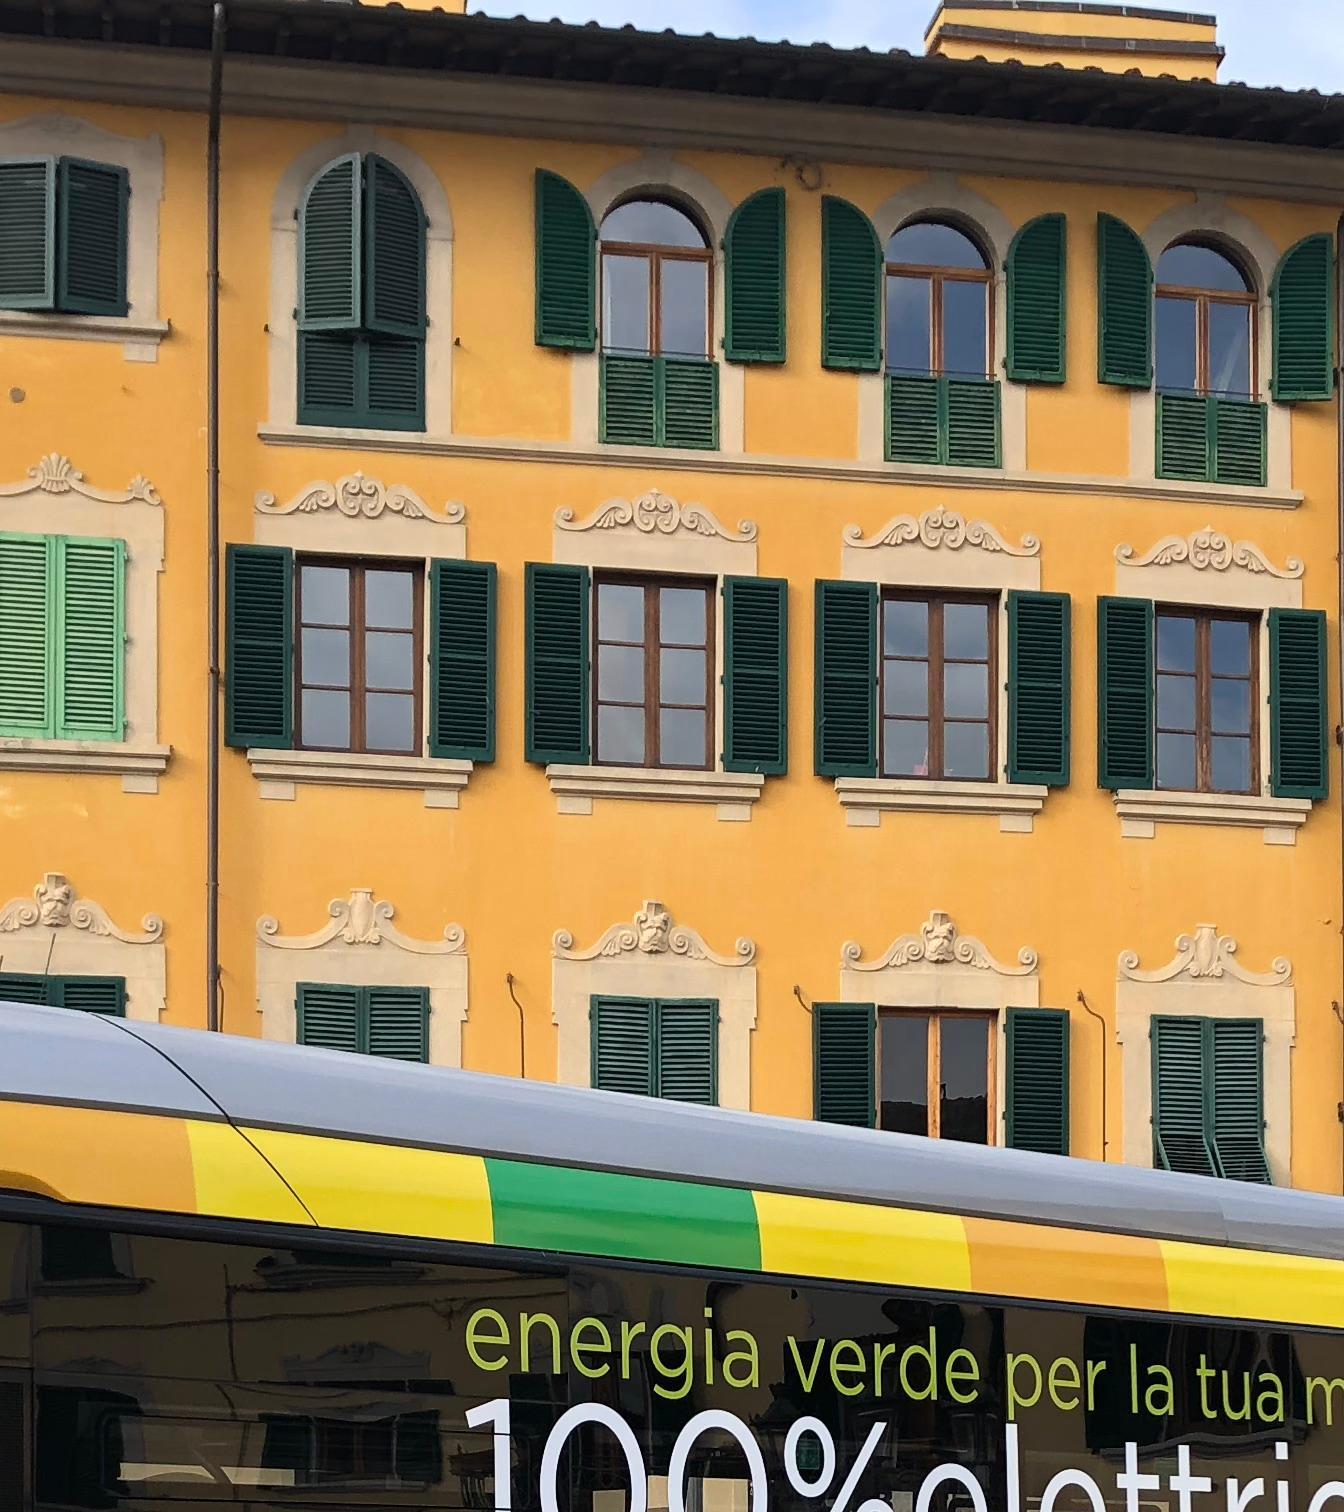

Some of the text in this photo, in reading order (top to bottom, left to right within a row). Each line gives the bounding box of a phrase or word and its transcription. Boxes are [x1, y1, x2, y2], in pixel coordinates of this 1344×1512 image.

[465, 1307, 760, 1400] energia
[787, 1326, 981, 1404] verde
[1006, 1352, 1106, 1421] per
[1130, 1343, 1175, 1416] la
[1196, 1354, 1285, 1422] tua
